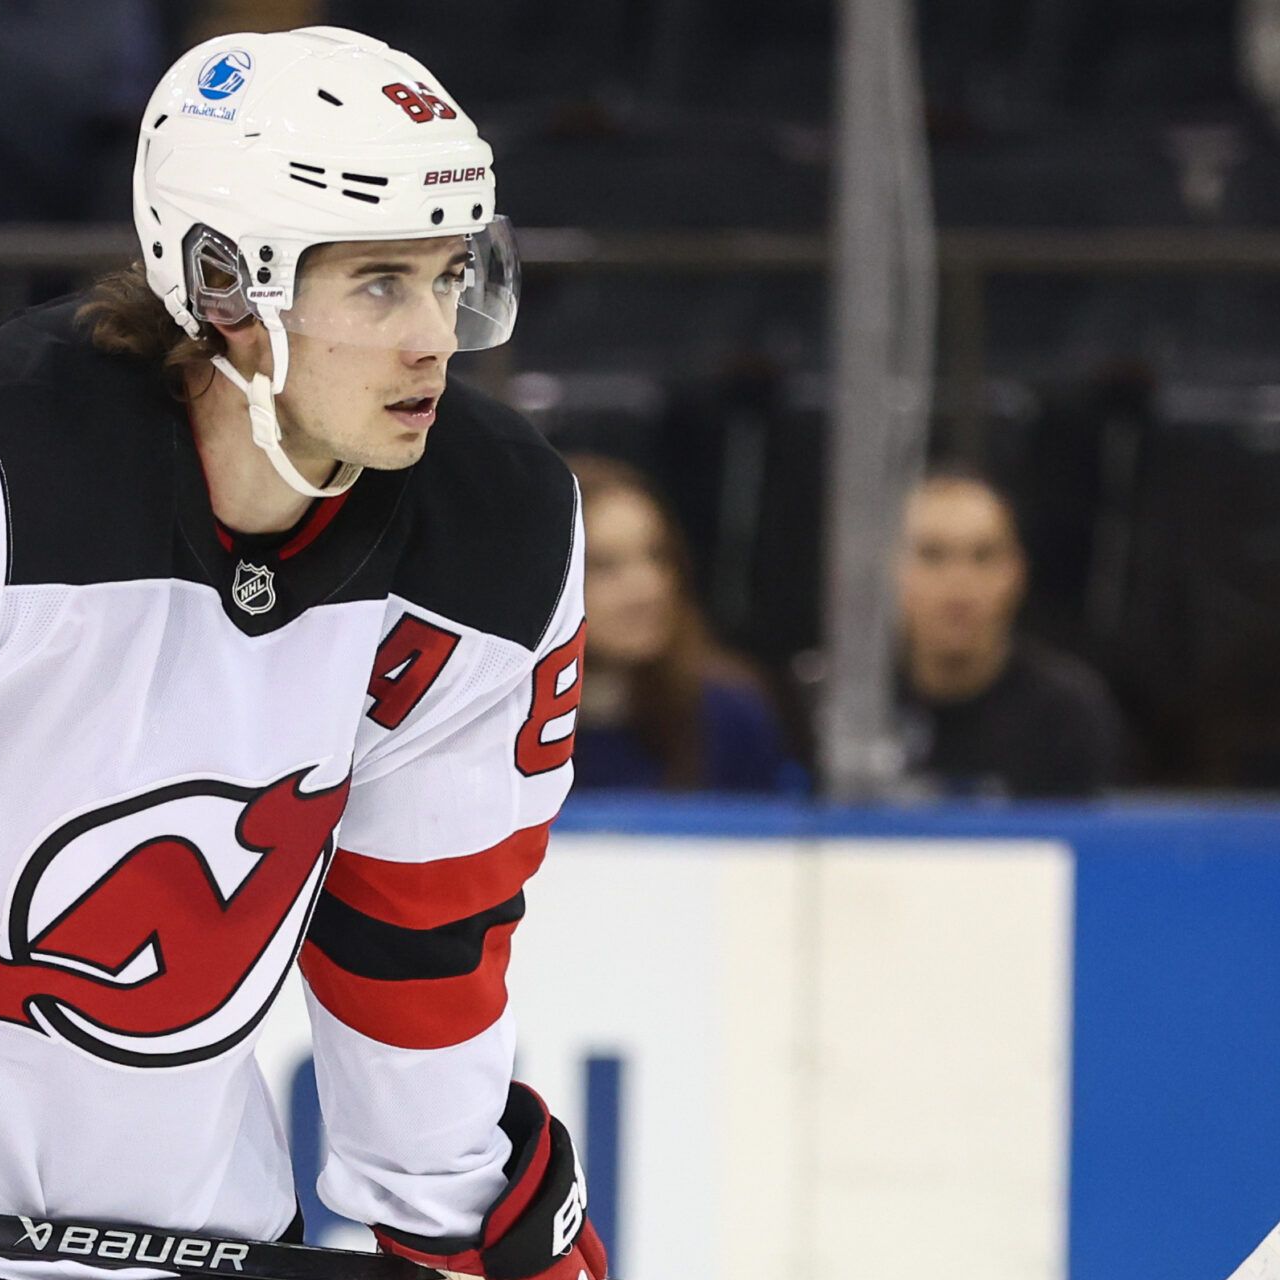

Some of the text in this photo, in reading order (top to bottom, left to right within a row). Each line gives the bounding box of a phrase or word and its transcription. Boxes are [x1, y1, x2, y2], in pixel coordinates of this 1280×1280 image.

[382, 81, 457, 123] 86
[424, 167, 485, 185] BAUER
[241, 578, 265, 601] NHL
[366, 611, 462, 731] A
[514, 616, 586, 777] 8
[57, 1226, 250, 1271] BAUER
